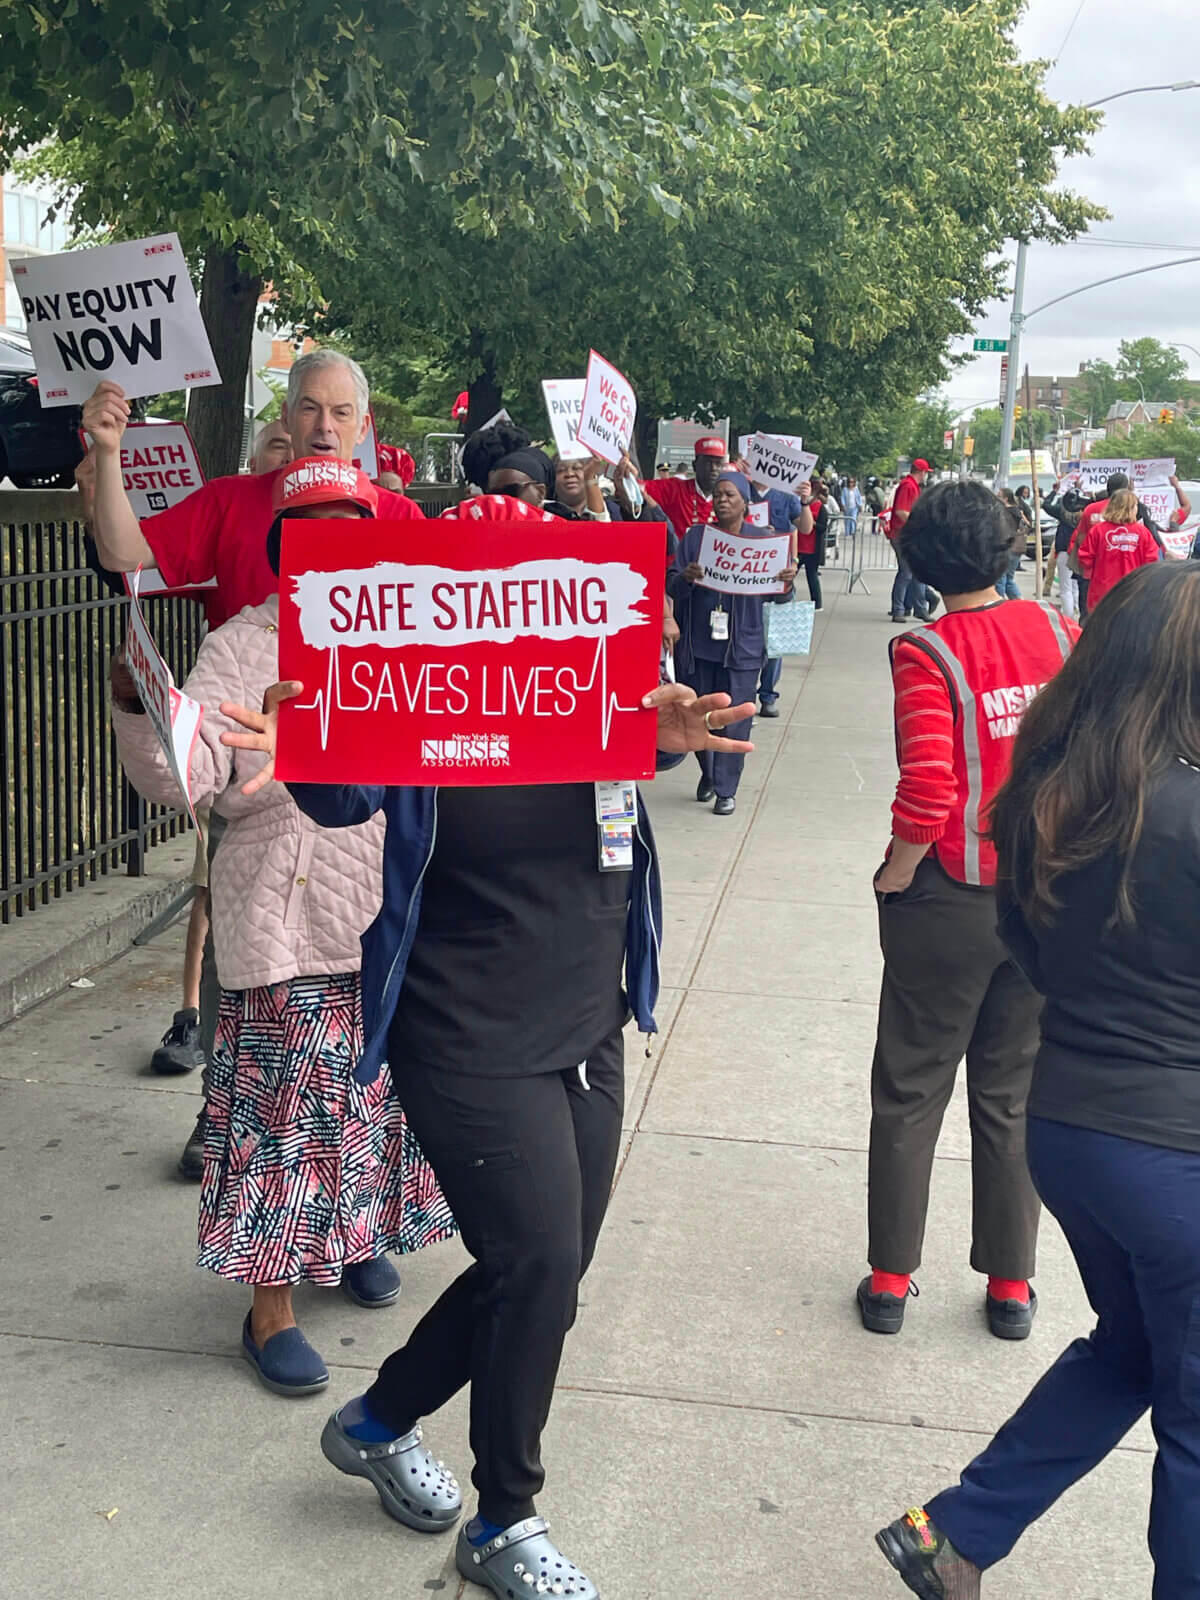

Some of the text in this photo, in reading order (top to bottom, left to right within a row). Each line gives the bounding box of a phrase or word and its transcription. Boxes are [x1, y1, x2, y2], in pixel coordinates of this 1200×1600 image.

[23, 275, 177, 323] PAY EQUITY
[53, 318, 162, 371] NOW
[600, 375, 618, 404] We
[552, 400, 572, 414] PAY
[600, 401, 619, 426] for
[588, 415, 611, 442] New
[120, 444, 187, 469] EALTH
[753, 443, 772, 458] PAY
[772, 452, 811, 472] EQUITY
[123, 468, 195, 490] USTICE
[283, 466, 358, 493] NURSES
[755, 459, 799, 484] NOW
[1089, 475, 1109, 485] NO
[1099, 466, 1128, 474] EQUITY
[284, 479, 359, 499] ASSOCIATION
[1139, 494, 1169, 504] ERY
[149, 495, 166, 509] IS
[1150, 505, 1169, 513] ENT
[713, 538, 778, 560] We Care
[704, 566, 777, 585] New Yorkers
[715, 556, 769, 574] for ALL
[329, 577, 608, 633] SAFE STAFFING
[350, 661, 577, 716] SAVES LIVES
[982, 682, 1048, 719] NYSN
[452, 733, 510, 741] New York State
[988, 716, 1021, 740] MA
[421, 739, 510, 760] NURSES
[420, 758, 511, 768] ASSOCIATION
